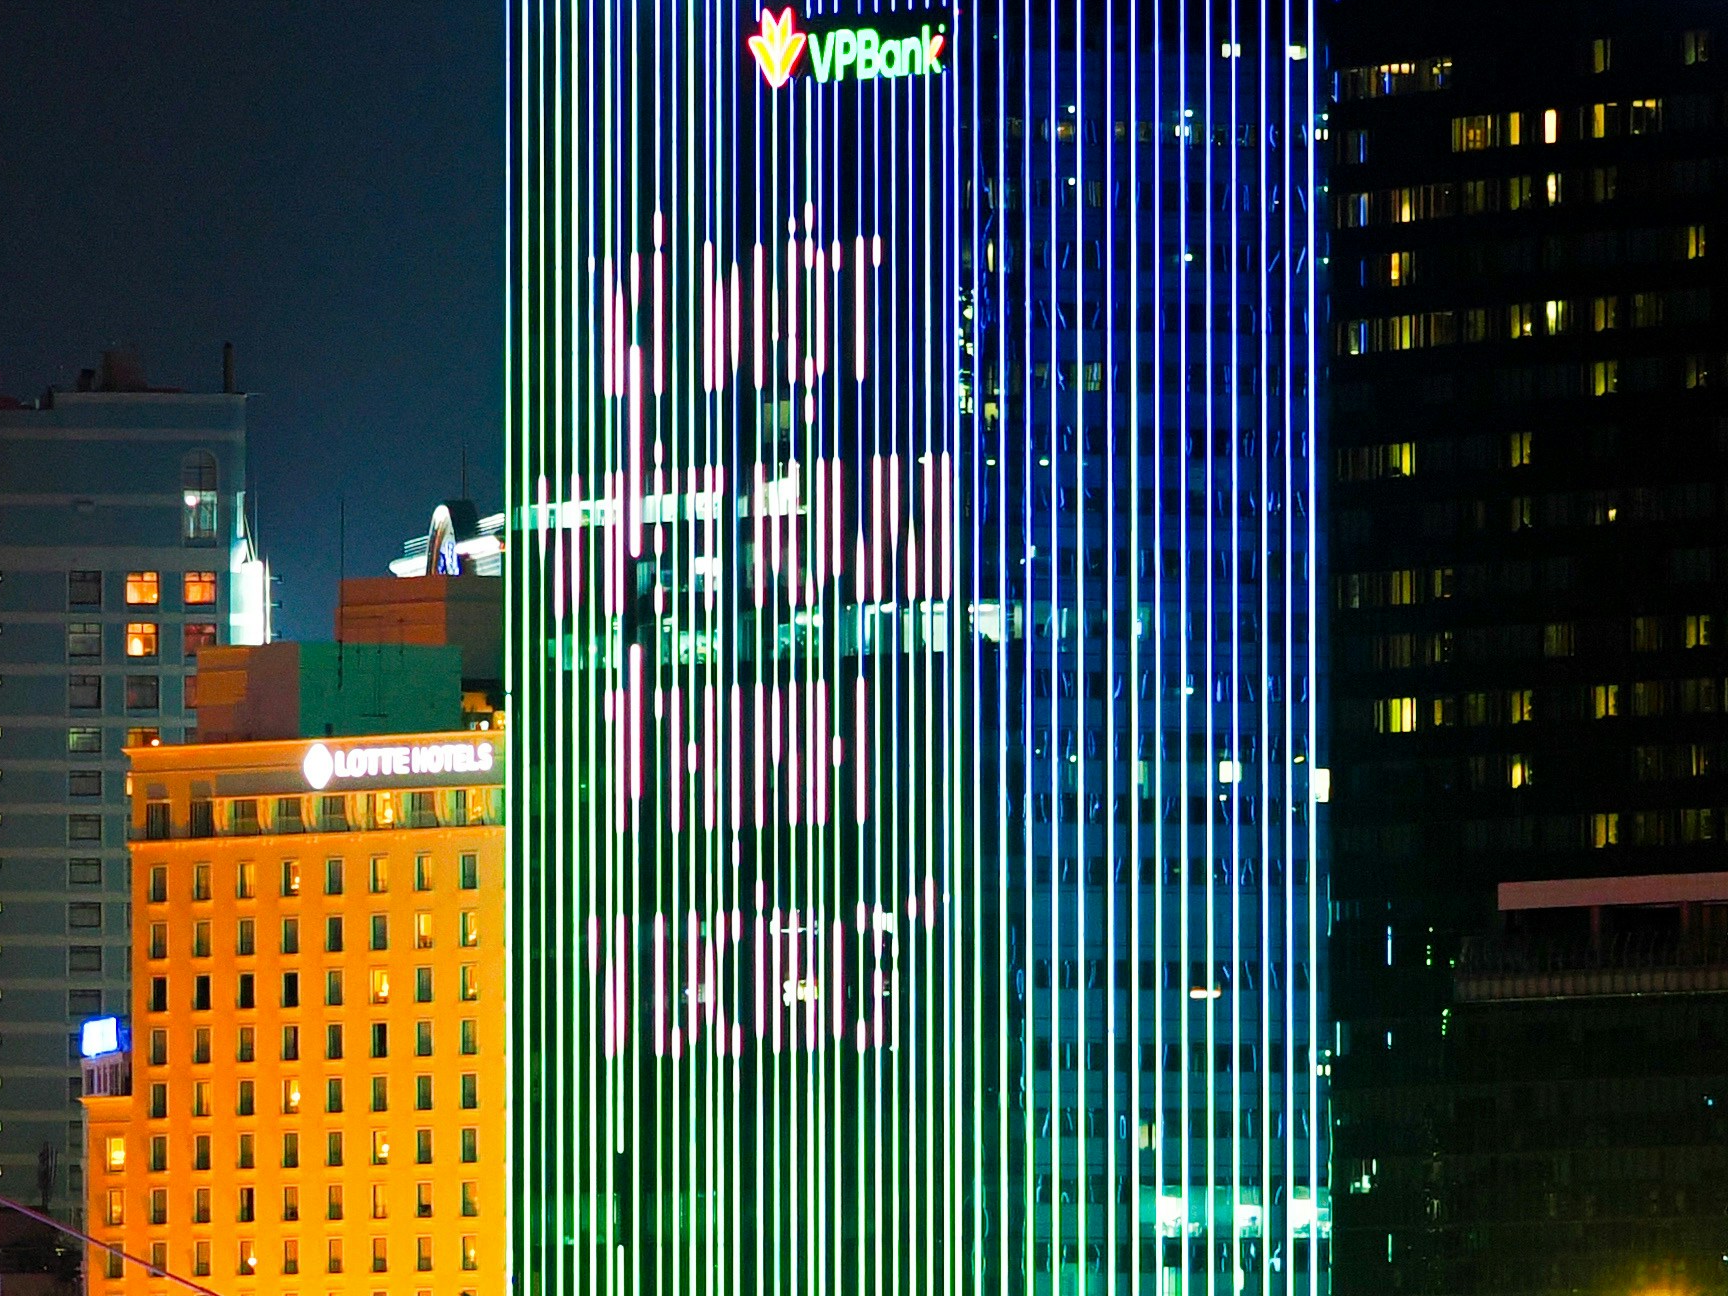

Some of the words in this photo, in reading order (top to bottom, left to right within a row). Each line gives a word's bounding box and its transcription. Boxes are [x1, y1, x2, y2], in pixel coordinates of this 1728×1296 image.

[808, 23, 946, 84] VPBank
[334, 746, 410, 777] LOTTE
[412, 743, 493, 773] HOTELS
